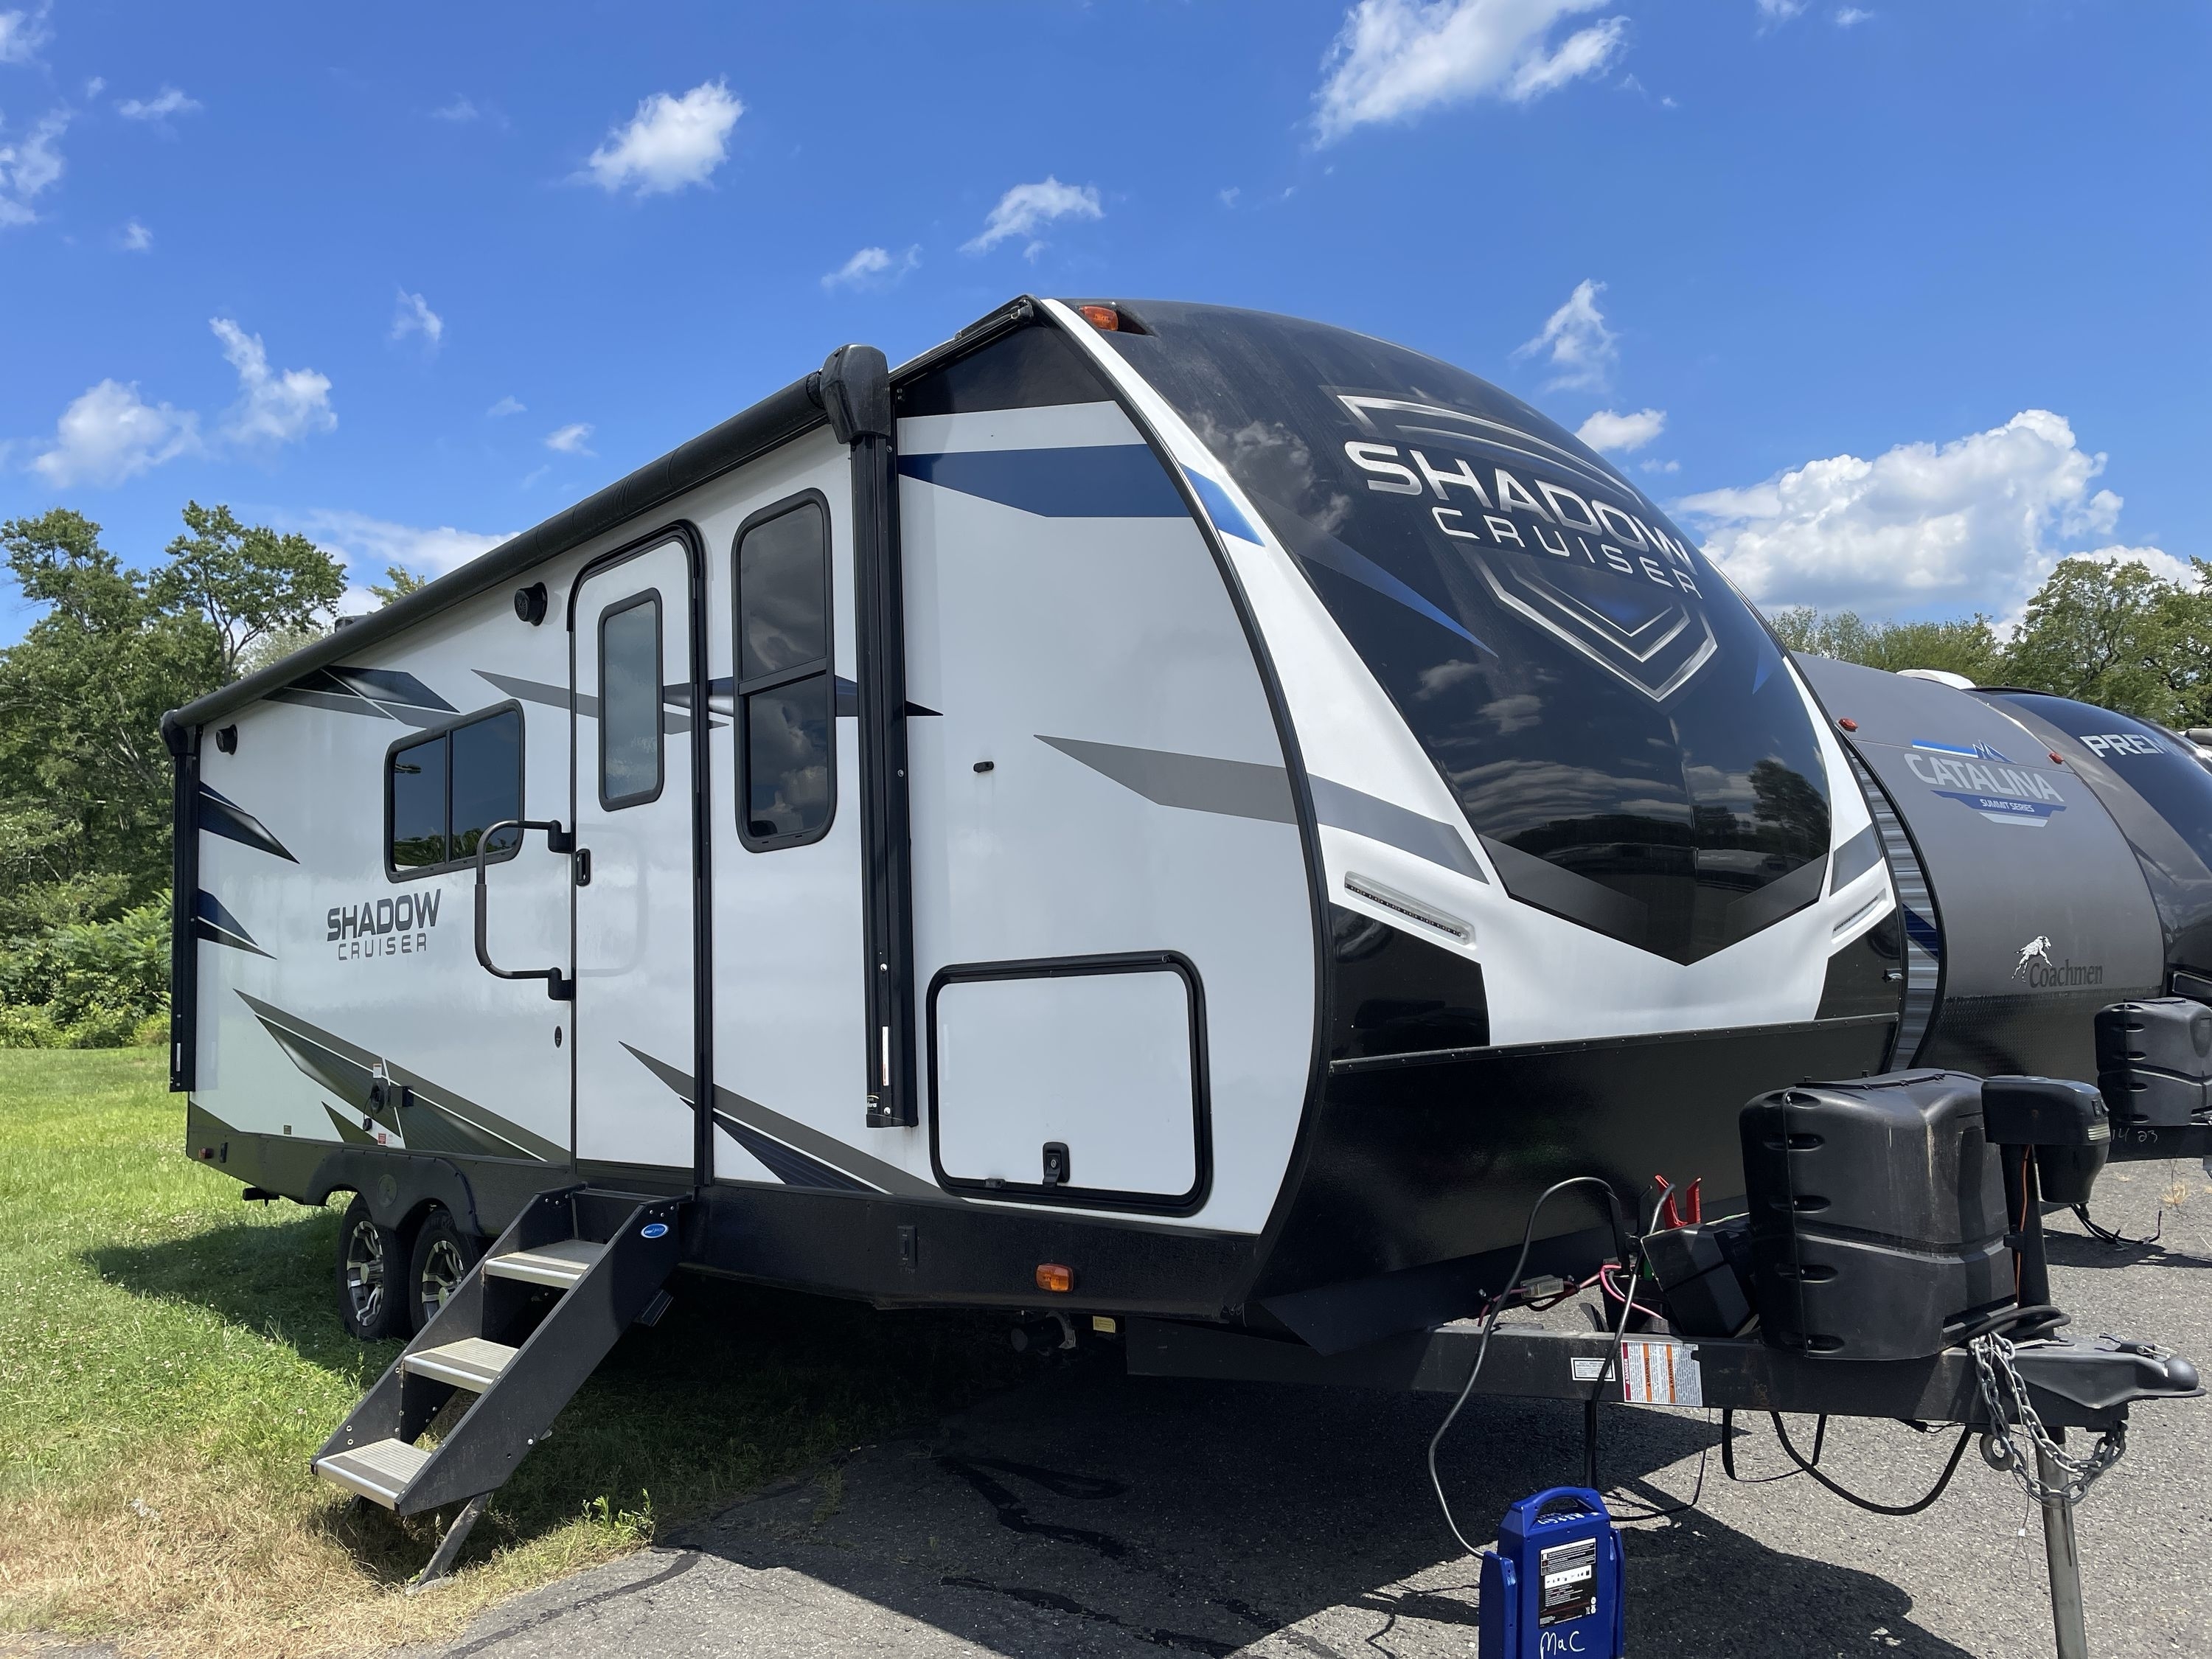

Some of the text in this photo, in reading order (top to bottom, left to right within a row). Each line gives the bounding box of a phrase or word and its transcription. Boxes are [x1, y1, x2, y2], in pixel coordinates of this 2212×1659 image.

[1344, 441, 1697, 575] SHADOW
[1432, 507, 1703, 599] CRUISER
[1904, 754, 2064, 801] CATALINA
[1980, 799, 2034, 812] SUMMIT SERIES
[327, 888, 441, 942] SHADOW
[338, 933, 426, 960] CRUISER
[2030, 959, 2103, 988] Coachmen
